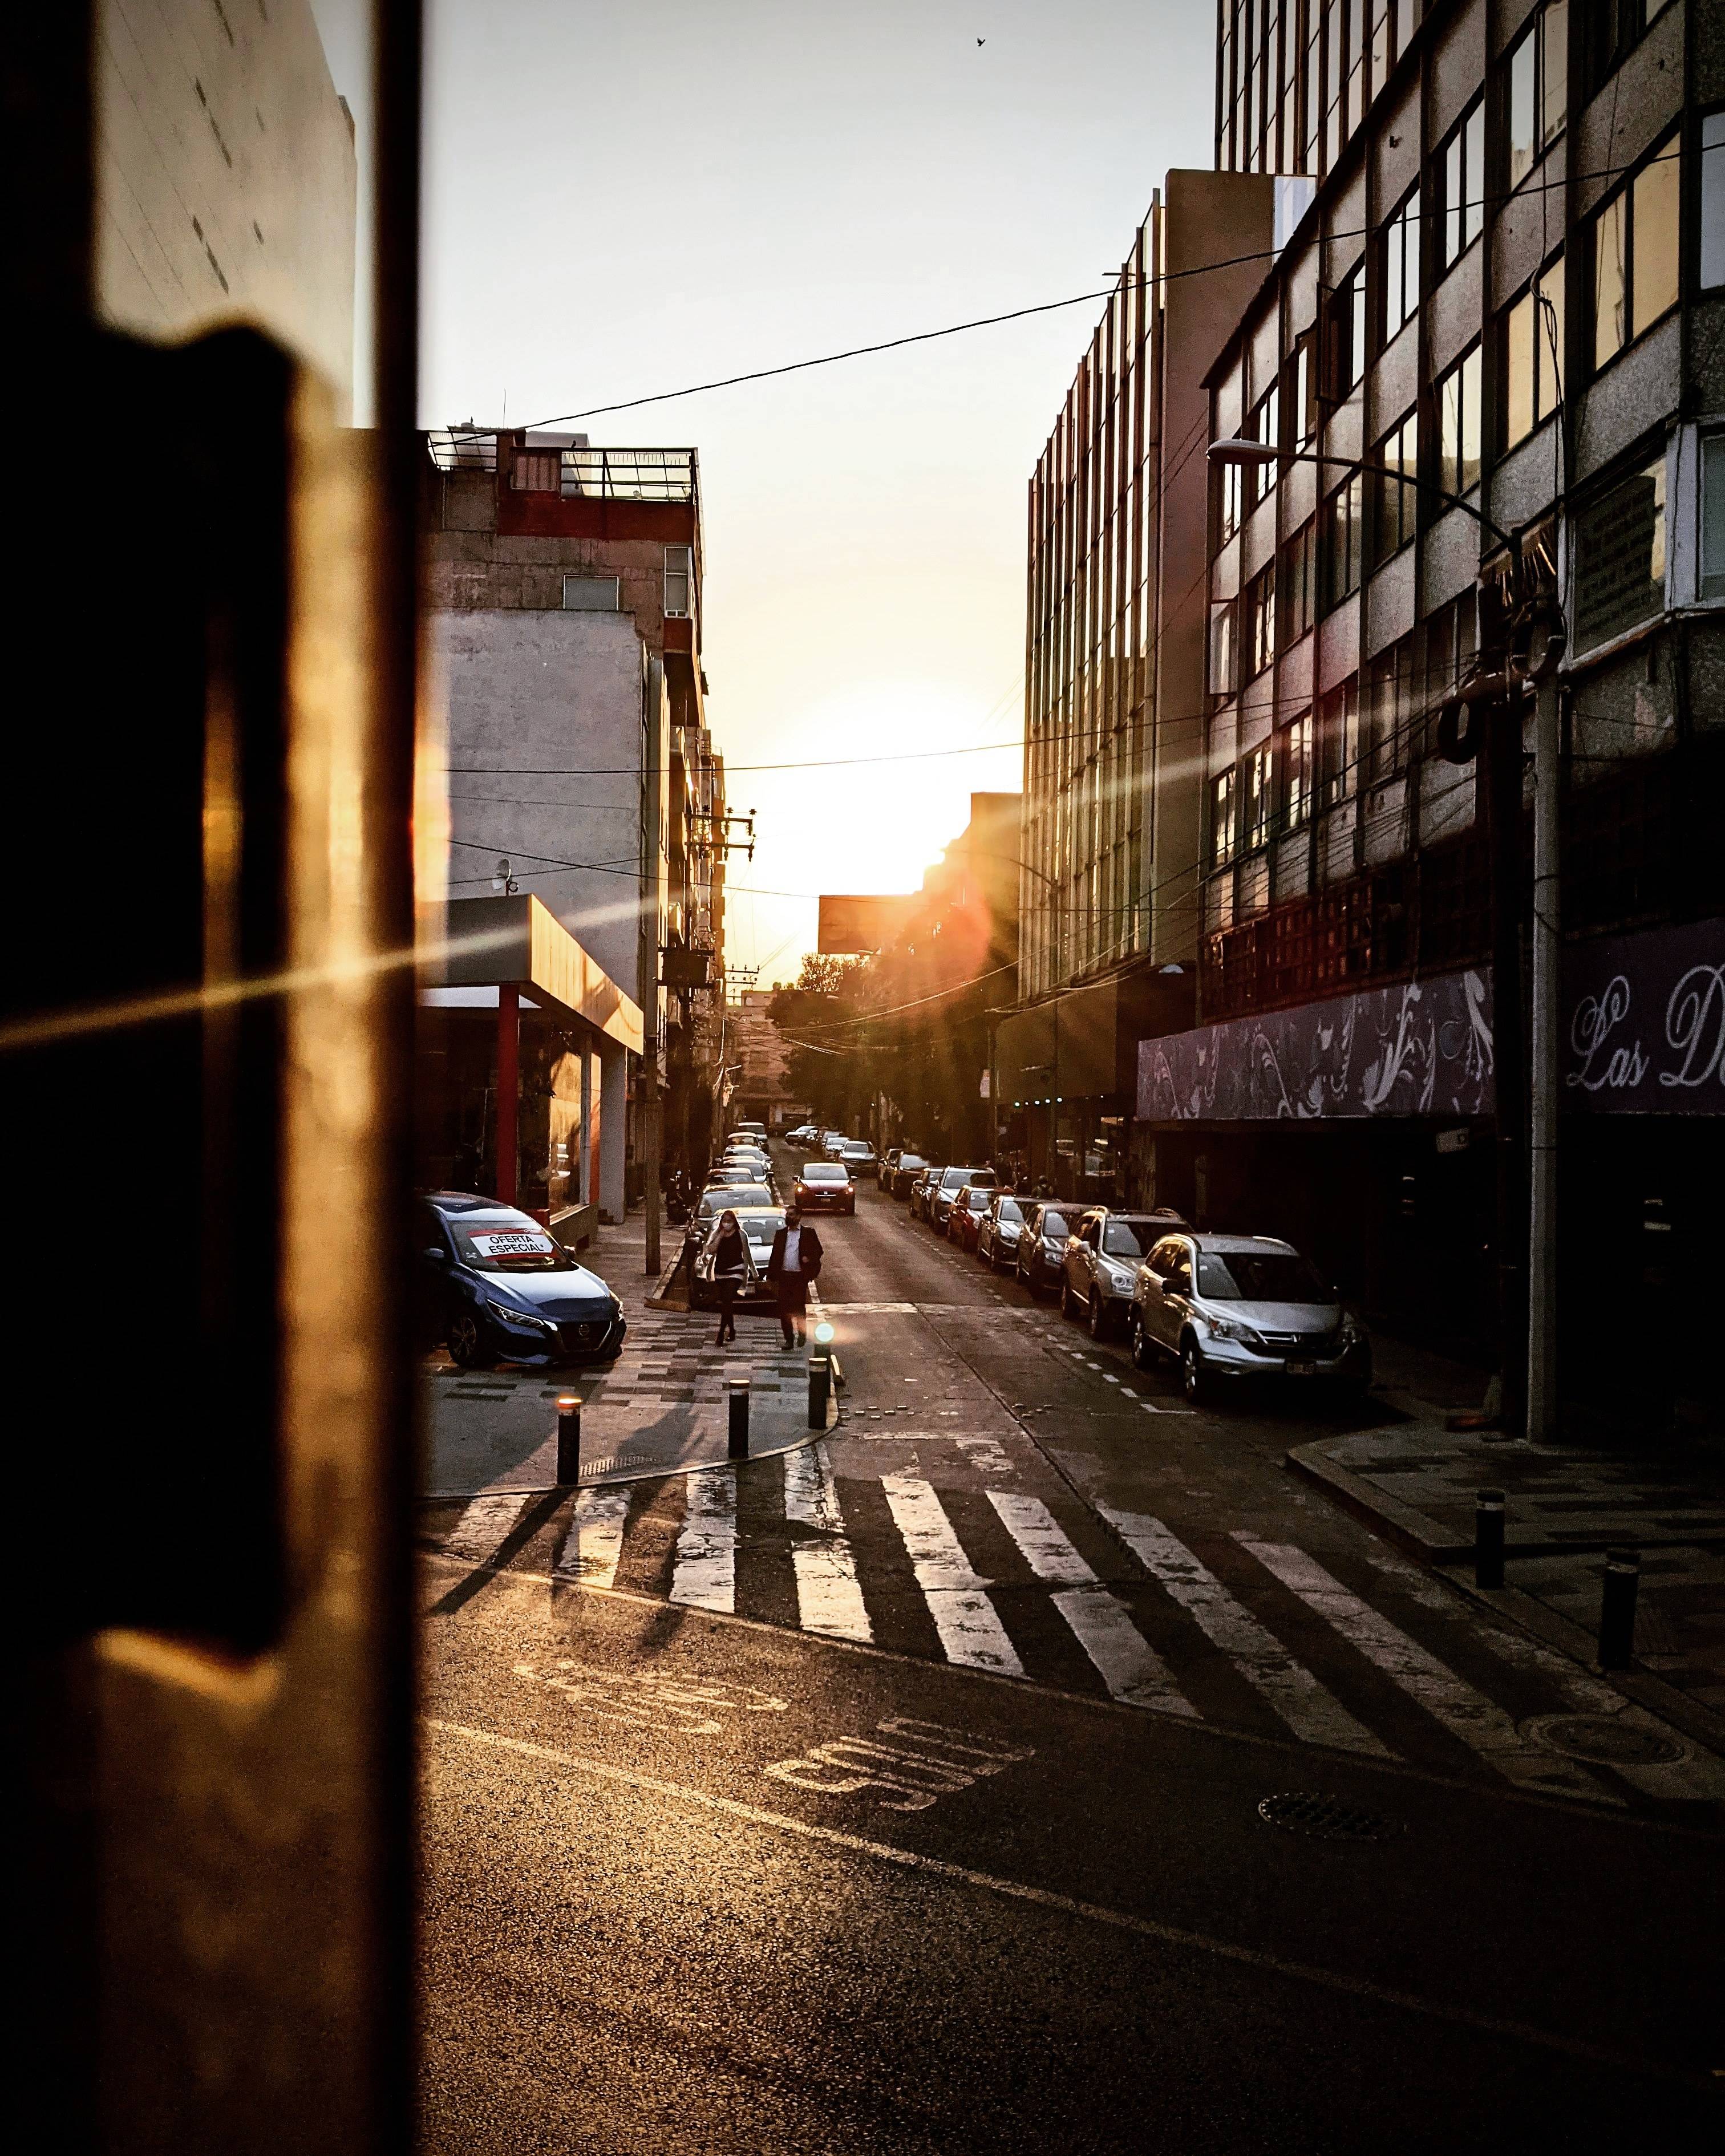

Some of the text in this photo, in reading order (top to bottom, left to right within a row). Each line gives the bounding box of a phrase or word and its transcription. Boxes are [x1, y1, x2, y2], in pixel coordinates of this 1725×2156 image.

[1566, 963, 1725, 1091] Las D
[490, 1235, 534, 1244] OFERTA
